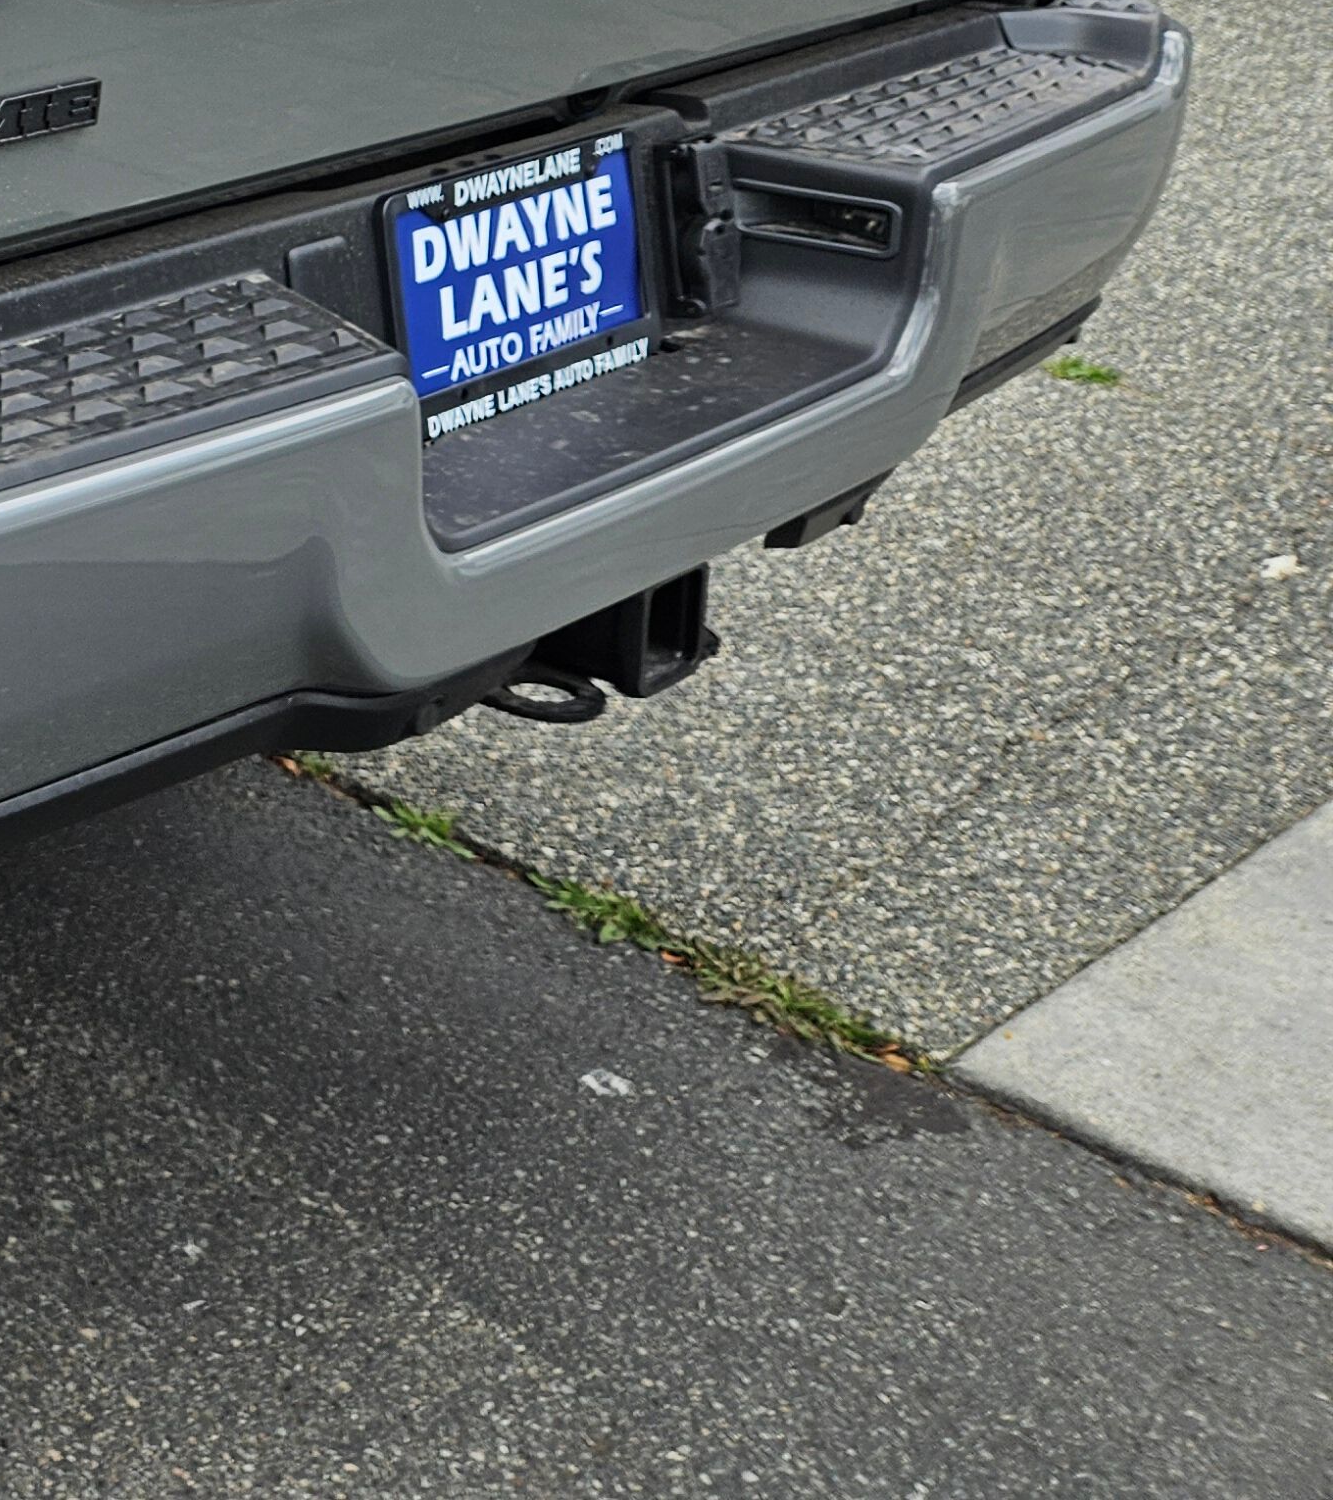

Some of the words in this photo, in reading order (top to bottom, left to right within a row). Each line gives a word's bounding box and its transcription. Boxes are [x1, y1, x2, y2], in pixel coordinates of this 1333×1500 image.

[454, 147, 581, 207] DWAYNELANE
[412, 174, 617, 284] DWAYNE
[439, 240, 603, 341] LANE'S
[427, 394, 496, 438] DWAYNE
[553, 359, 594, 391] AUTO
[592, 337, 649, 376] FAMILY
[450, 332, 523, 382] AUTO
[529, 301, 601, 355] FAMILY
